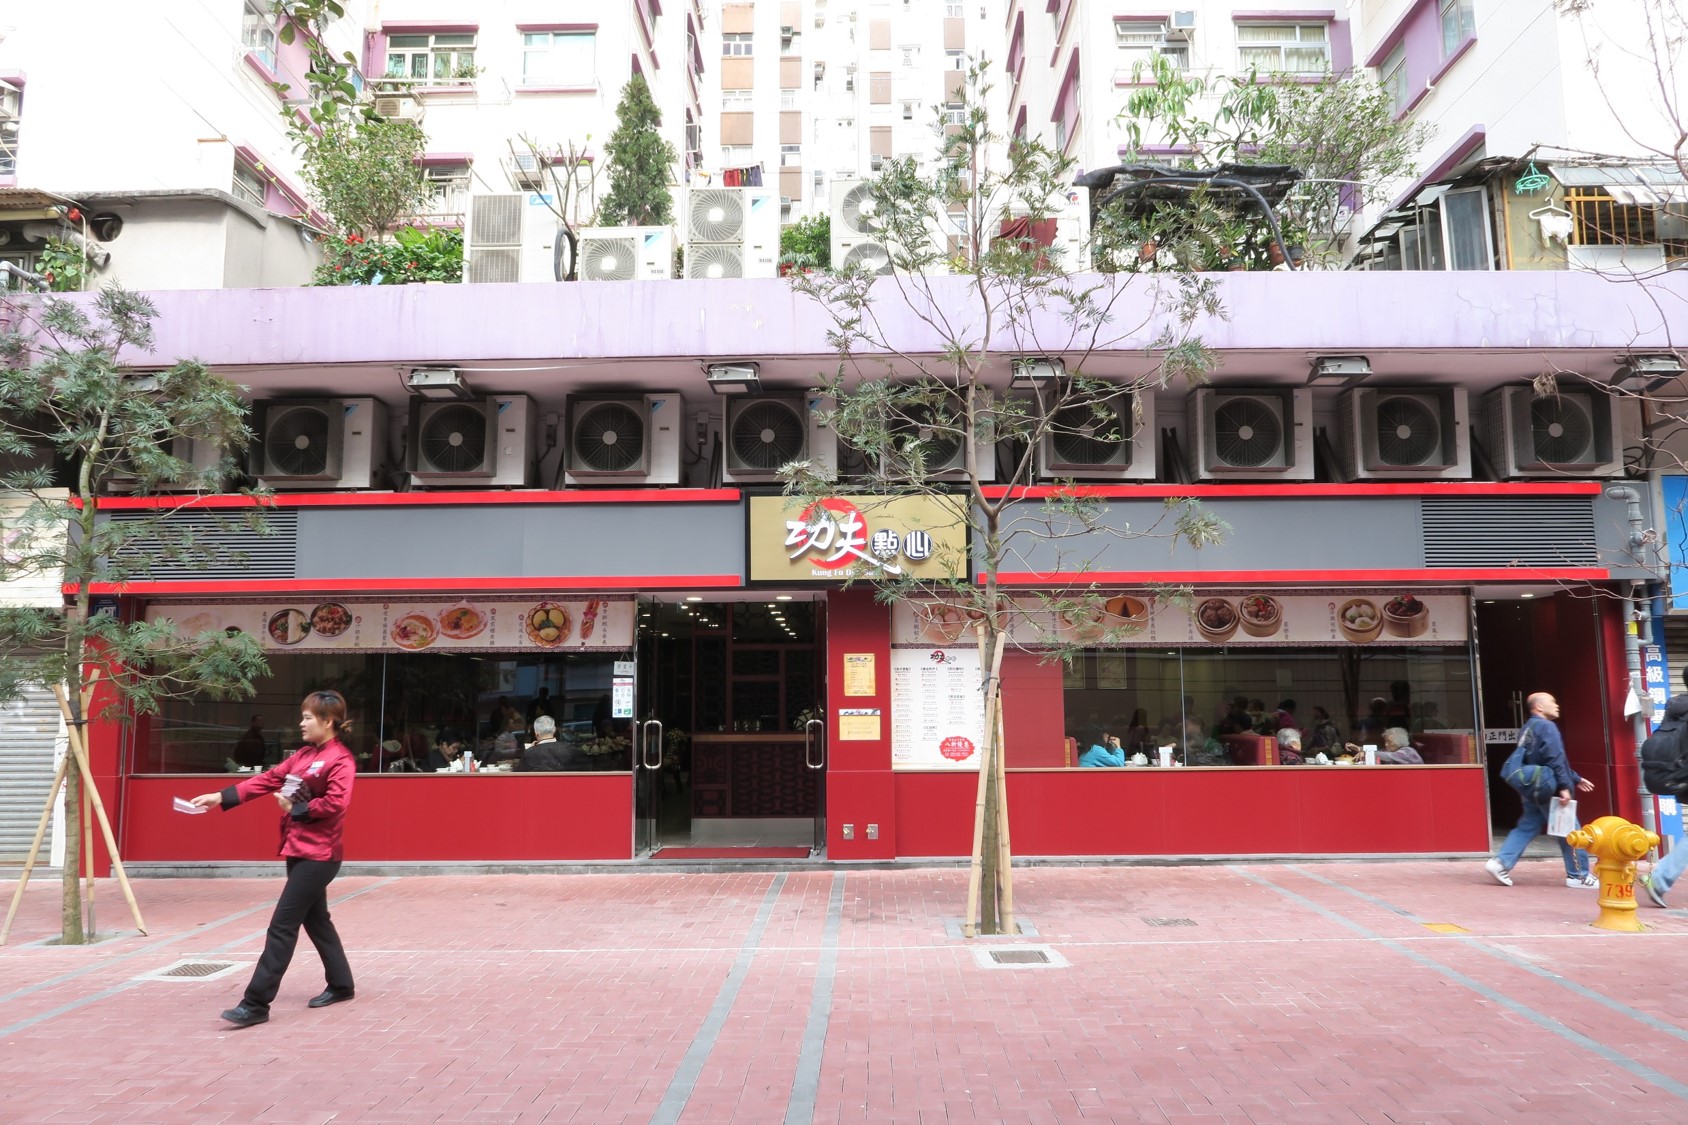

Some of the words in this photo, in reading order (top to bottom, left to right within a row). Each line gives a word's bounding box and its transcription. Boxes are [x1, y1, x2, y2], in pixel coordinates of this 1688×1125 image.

[784, 510, 932, 574] 功夫點心
[812, 569, 832, 577] Kung
[1484, 730, 1521, 742] 正門出
[1606, 883, 1633, 898] 739
